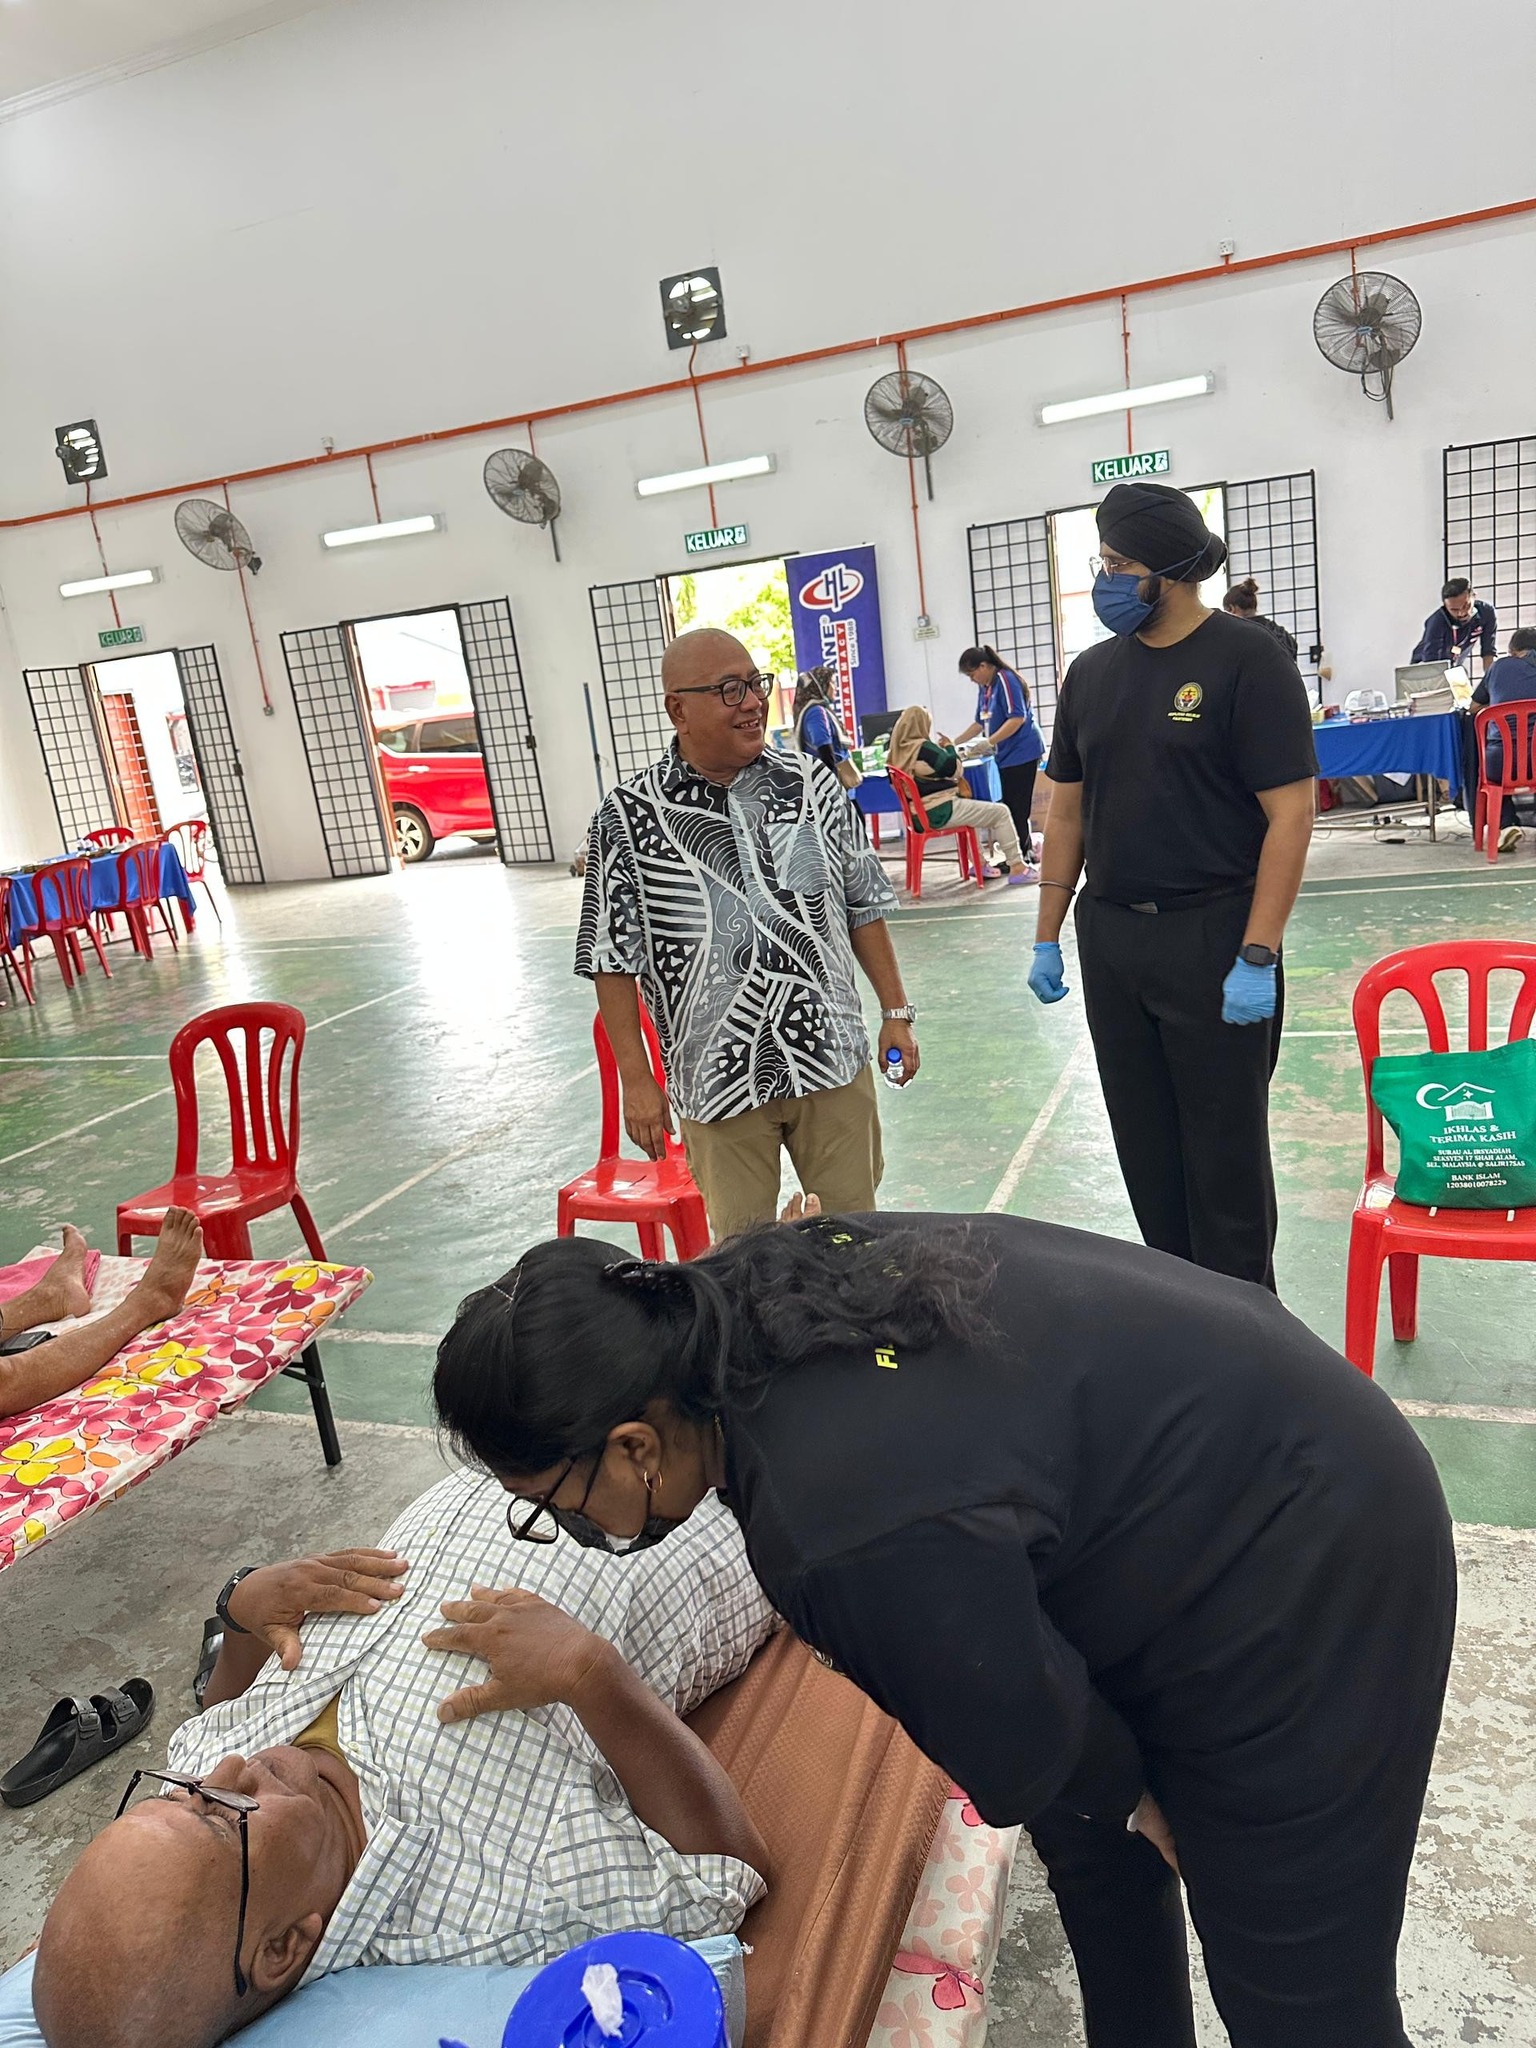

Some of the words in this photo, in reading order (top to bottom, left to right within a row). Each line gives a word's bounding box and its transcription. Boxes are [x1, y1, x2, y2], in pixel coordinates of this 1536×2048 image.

[1094, 455, 1153, 481] KELUAR
[686, 528, 735, 552] KELUAR
[101, 629, 134, 646] KELUAR
[836, 626, 853, 718] PHARMACY
[1429, 1134, 1477, 1144] TERIMA
[1480, 1131, 1517, 1143] KASIH
[1443, 1125, 1487, 1135] IKHLAS
[1489, 1124, 1500, 1132] &
[1475, 1172, 1501, 1180] ISLAM
